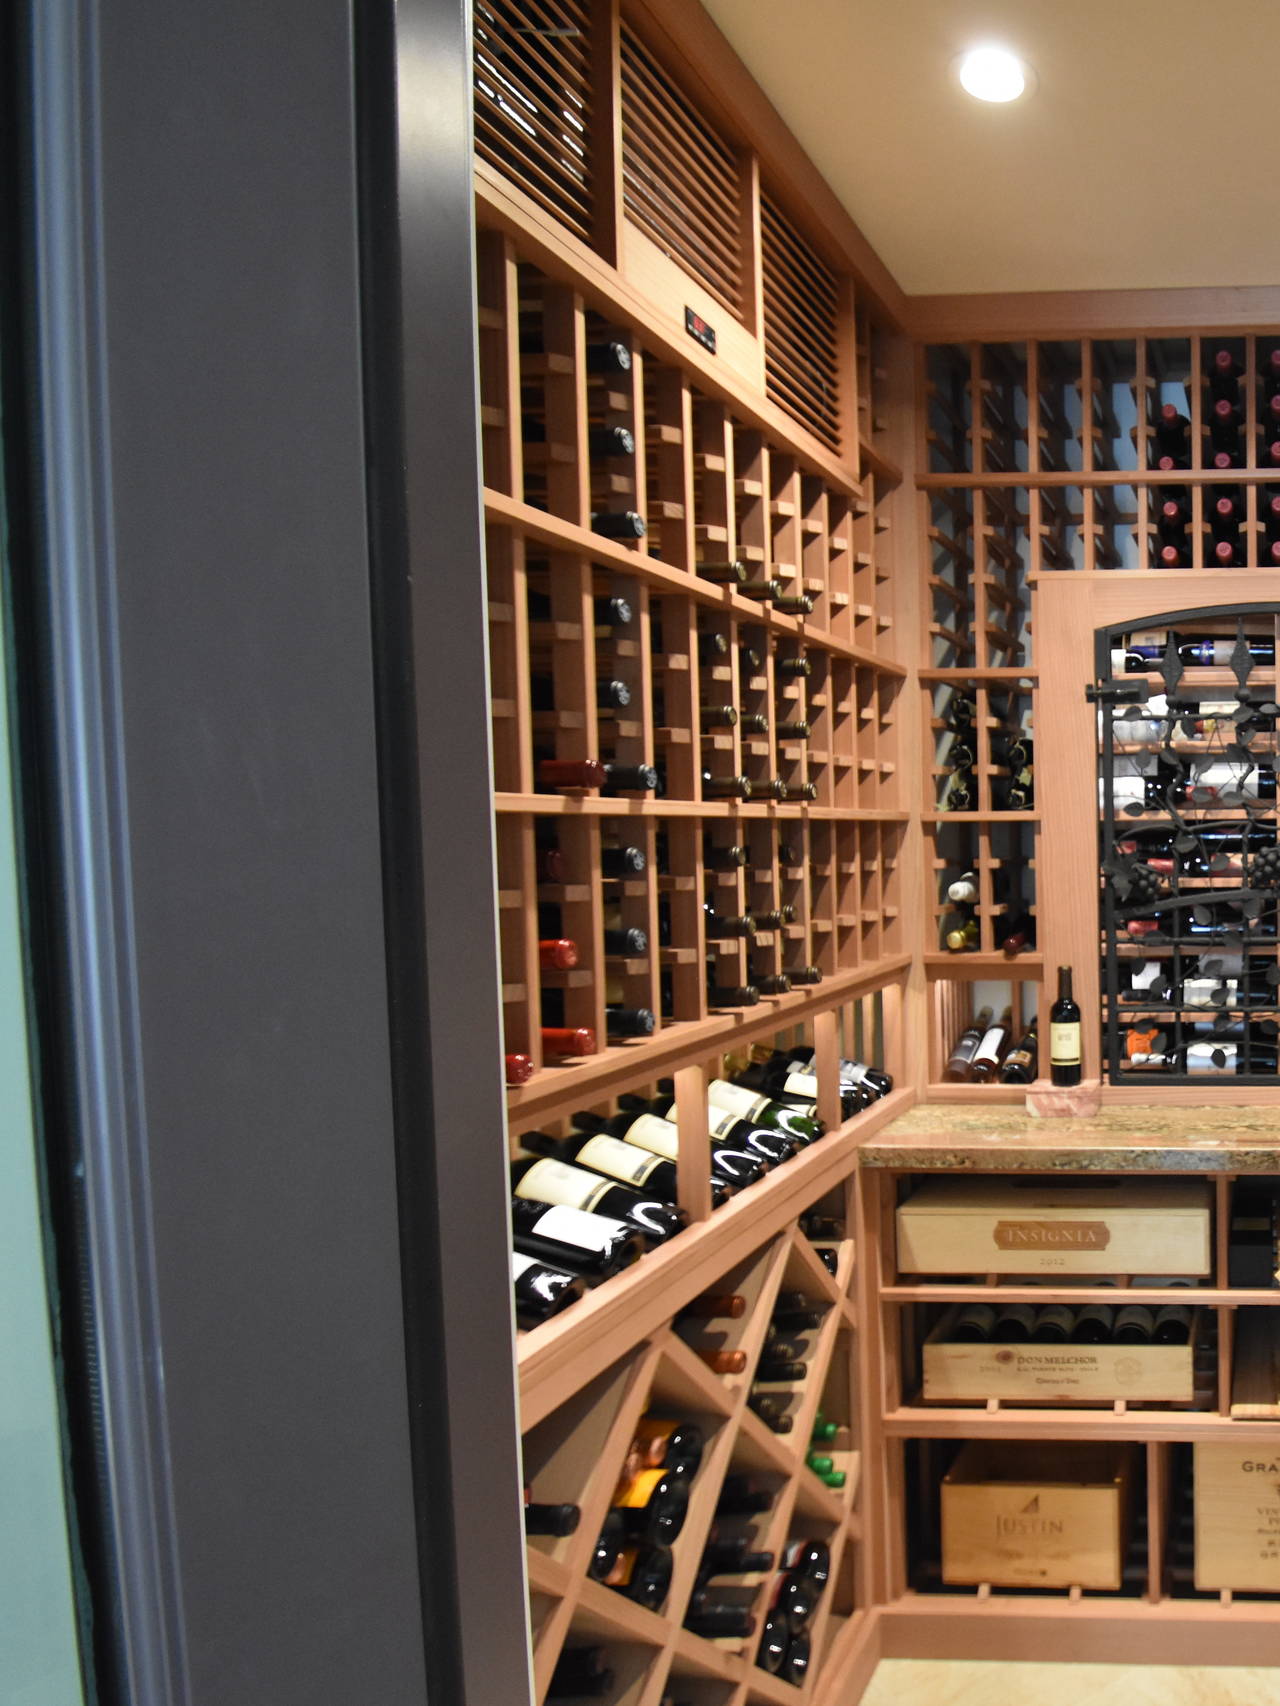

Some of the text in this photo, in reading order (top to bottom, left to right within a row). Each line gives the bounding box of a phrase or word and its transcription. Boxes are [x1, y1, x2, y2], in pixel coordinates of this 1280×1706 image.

[1007, 1229, 1097, 1242] INSIGNIA
[1017, 1356, 1097, 1365] DON MELCHOR
[996, 1514, 1064, 1544] JUSTIN
